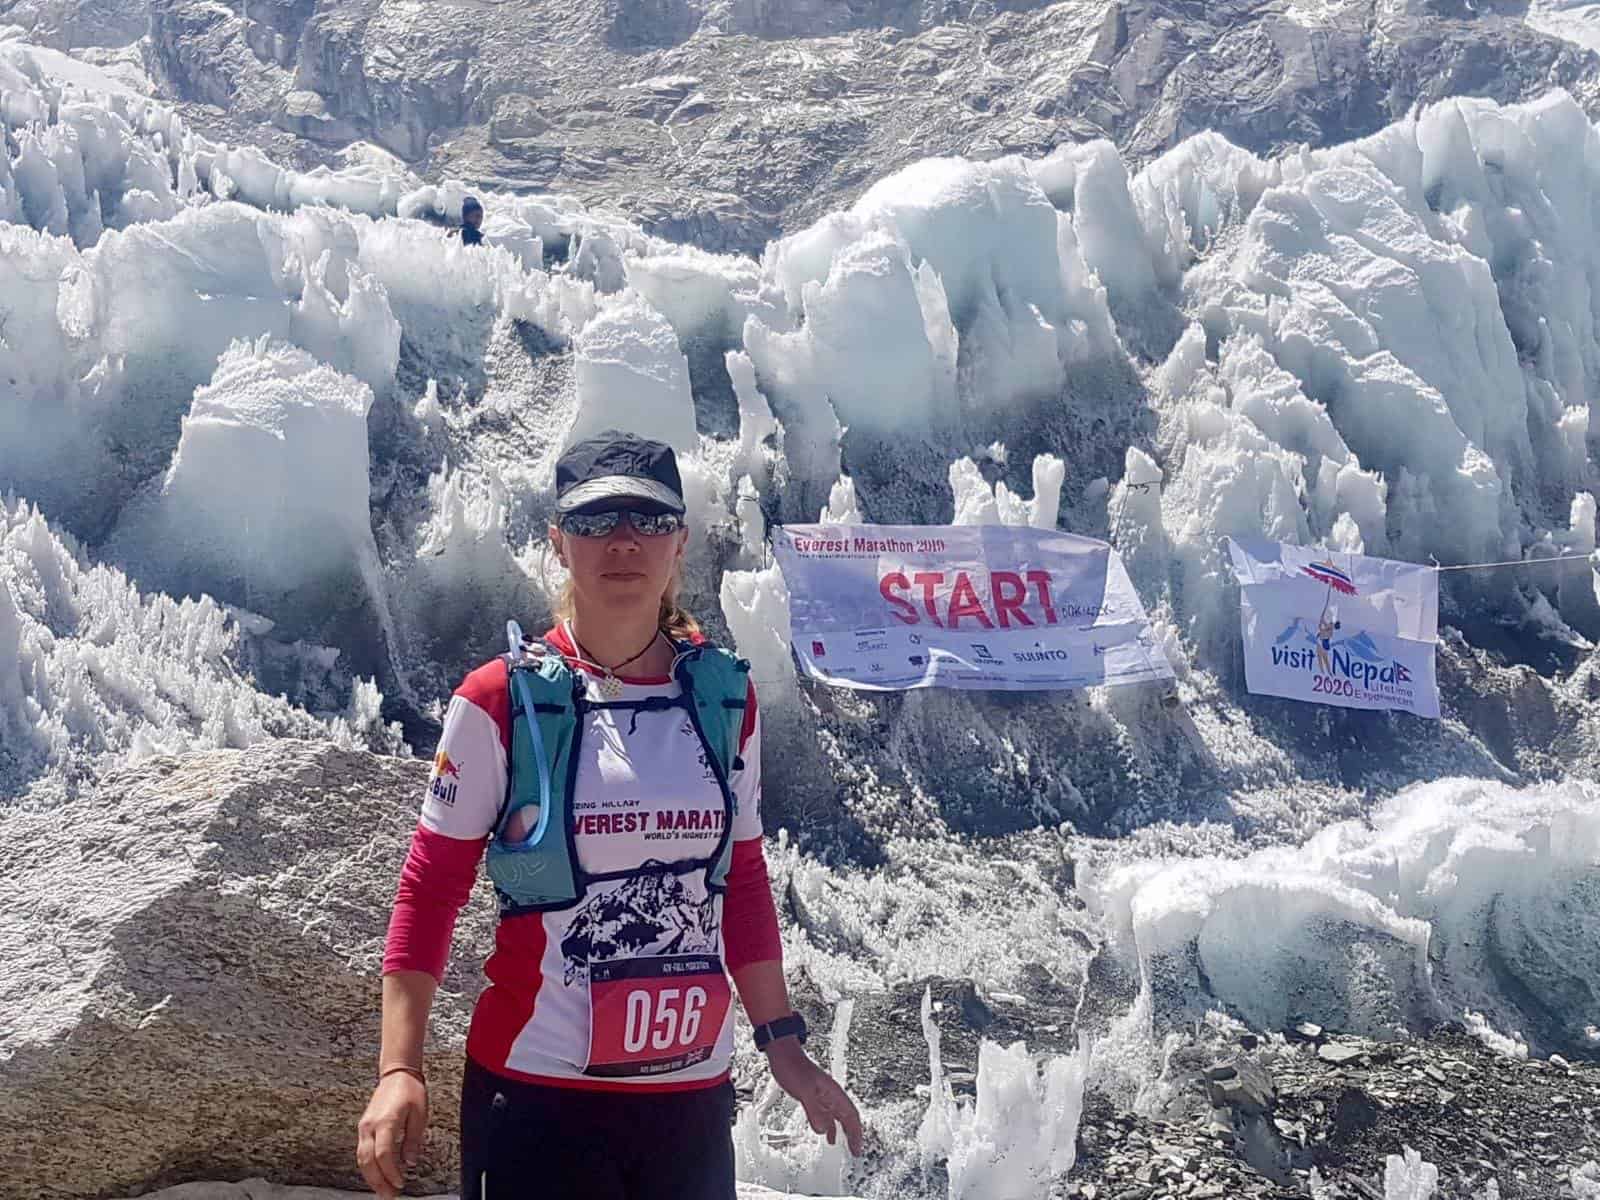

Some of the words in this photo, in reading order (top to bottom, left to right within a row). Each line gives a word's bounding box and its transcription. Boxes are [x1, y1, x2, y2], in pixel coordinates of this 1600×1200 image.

[795, 537, 849, 552] Everest
[854, 537, 914, 553] Marathon
[880, 570, 1060, 629] START
[1013, 649, 1067, 662] SUUNTO
[1312, 675, 1353, 697] 2020
[432, 777, 457, 803] Bull
[574, 811, 650, 835] VEREST
[624, 986, 707, 1052] 056
